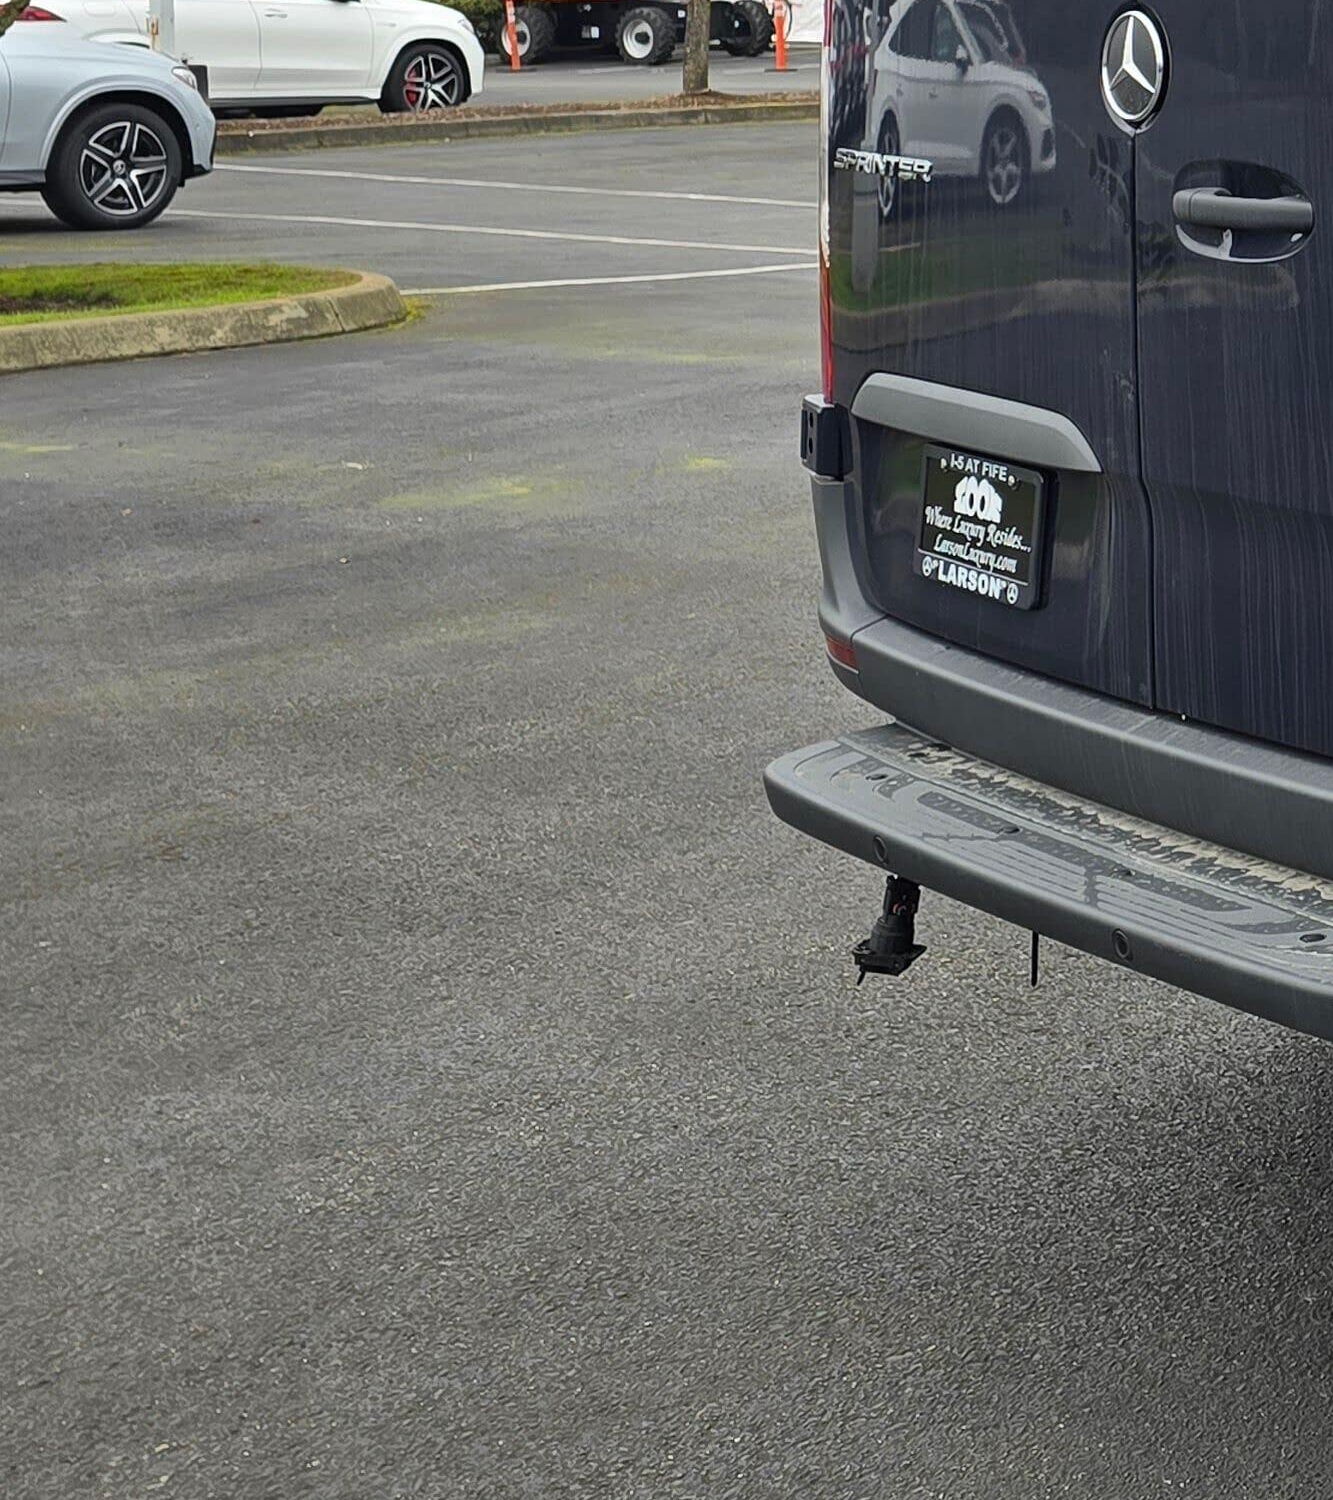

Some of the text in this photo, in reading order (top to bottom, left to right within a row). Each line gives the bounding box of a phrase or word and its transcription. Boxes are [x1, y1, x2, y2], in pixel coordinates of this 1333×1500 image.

[833, 147, 934, 183] SPRINTER
[965, 458, 980, 474] AT
[982, 461, 1008, 482] FIFE
